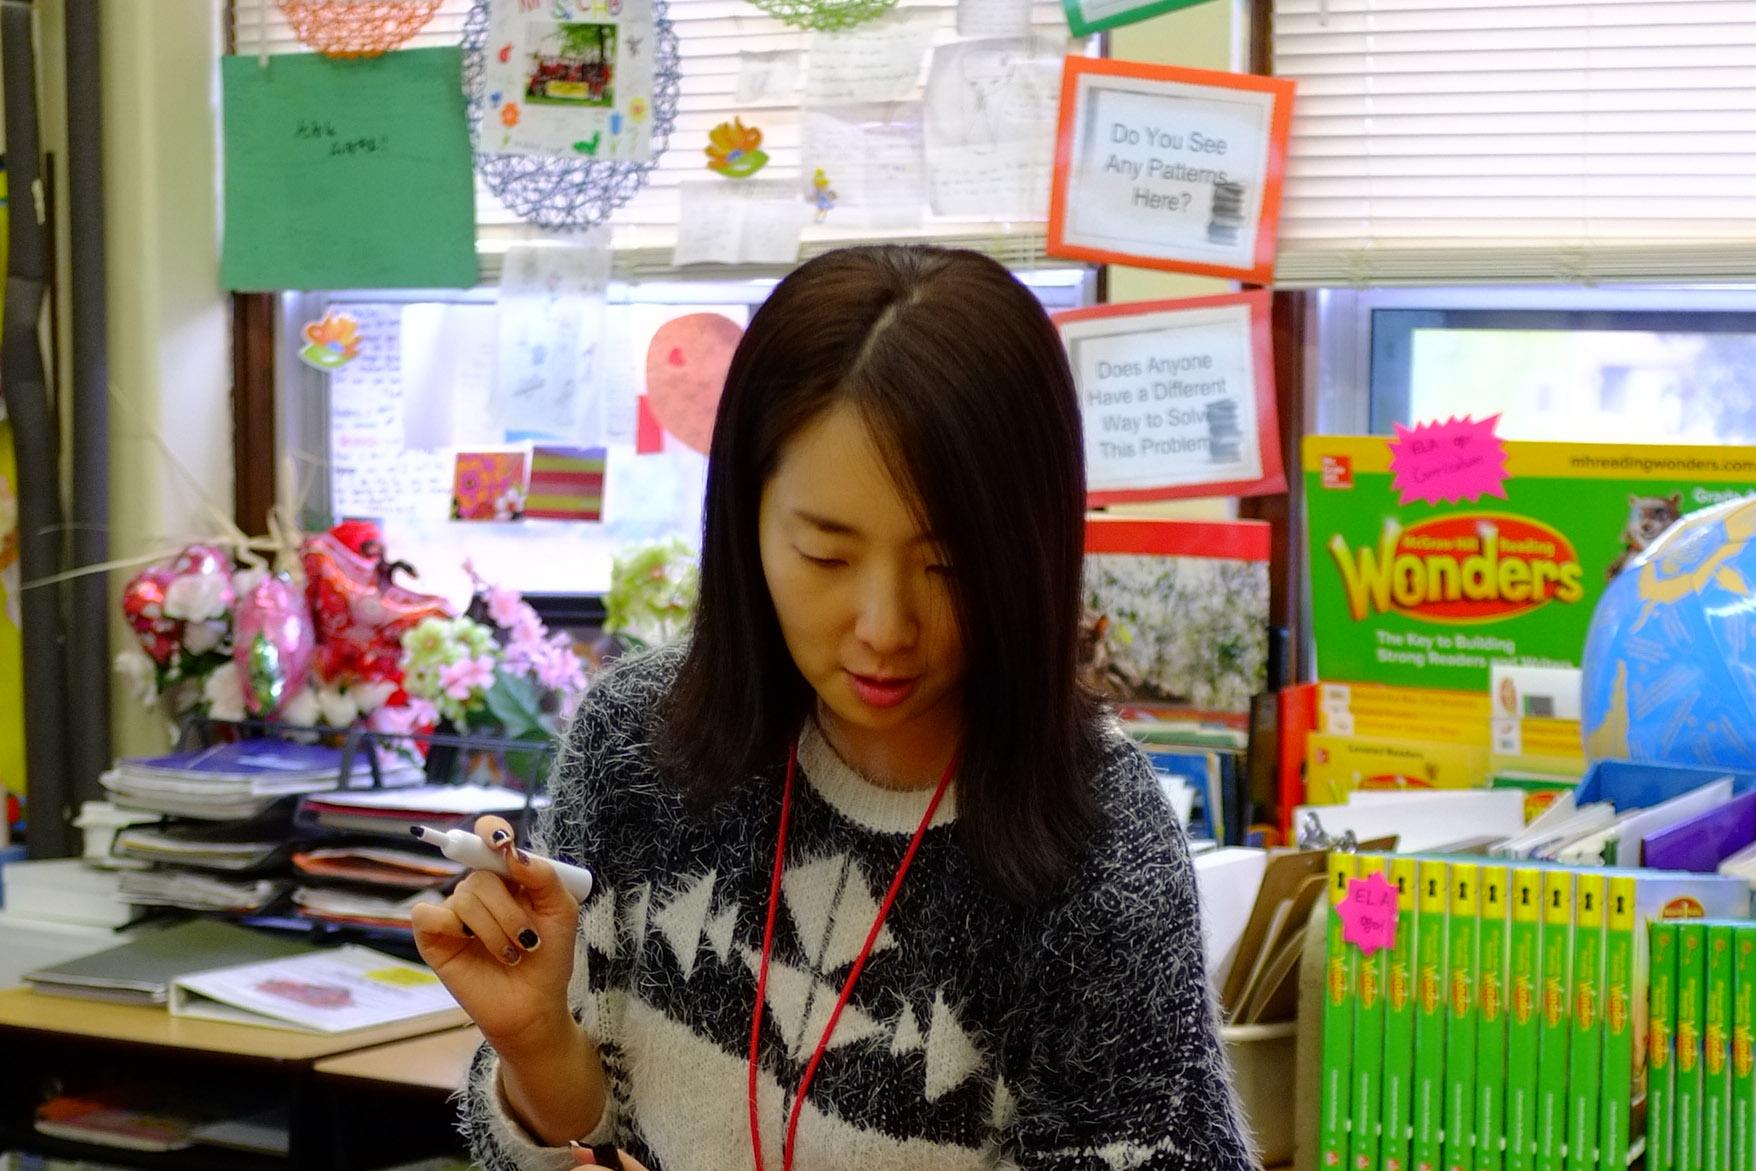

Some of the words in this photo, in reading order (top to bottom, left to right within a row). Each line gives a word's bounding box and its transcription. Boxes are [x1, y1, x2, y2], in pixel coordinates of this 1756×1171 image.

[1111, 122, 1140, 146] Do
[1145, 126, 1184, 150] You
[1189, 131, 1228, 155] See
[1103, 153, 1142, 181] Any
[1147, 157, 1229, 186] Patterns
[1131, 186, 1193, 212] Here?
[1097, 361, 1143, 380] Does
[1148, 354, 1213, 377] Anyone
[1088, 387, 1133, 406] Have
[1138, 387, 1149, 402] a
[1153, 378, 1228, 402] Different
[1103, 413, 1141, 434] Way
[1147, 413, 1163, 429] to
[1168, 406, 1208, 427] Solv
[1101, 440, 1137, 460] This
[1141, 436, 1212, 456] Problem
[1571, 456, 1756, 474] mhreadingwonders.com
[1329, 517, 1584, 622] Wonders
[1376, 630, 1403, 645] The
[1406, 632, 1433, 649] Key
[1436, 635, 1452, 648] to
[1454, 633, 1516, 655] Building
[1377, 648, 1425, 667] Strong
[1355, 889, 1389, 906] ELA
